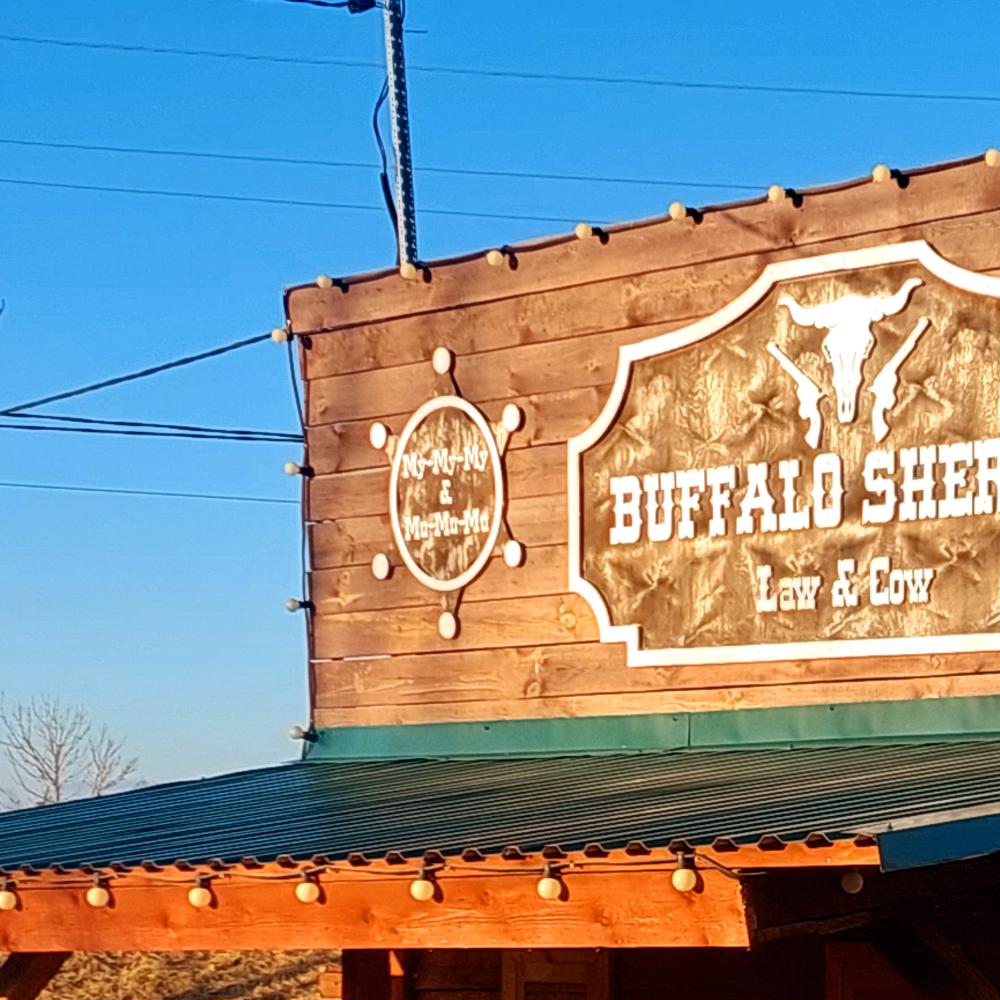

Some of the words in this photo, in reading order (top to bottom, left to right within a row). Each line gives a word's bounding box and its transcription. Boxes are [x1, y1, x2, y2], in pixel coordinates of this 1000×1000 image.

[402, 445, 488, 480] My-My-My
[439, 479, 453, 504] &
[609, 453, 845, 545] BUFFALO
[755, 563, 821, 613] Law
[832, 558, 860, 607] &
[869, 557, 938, 606] Cow
